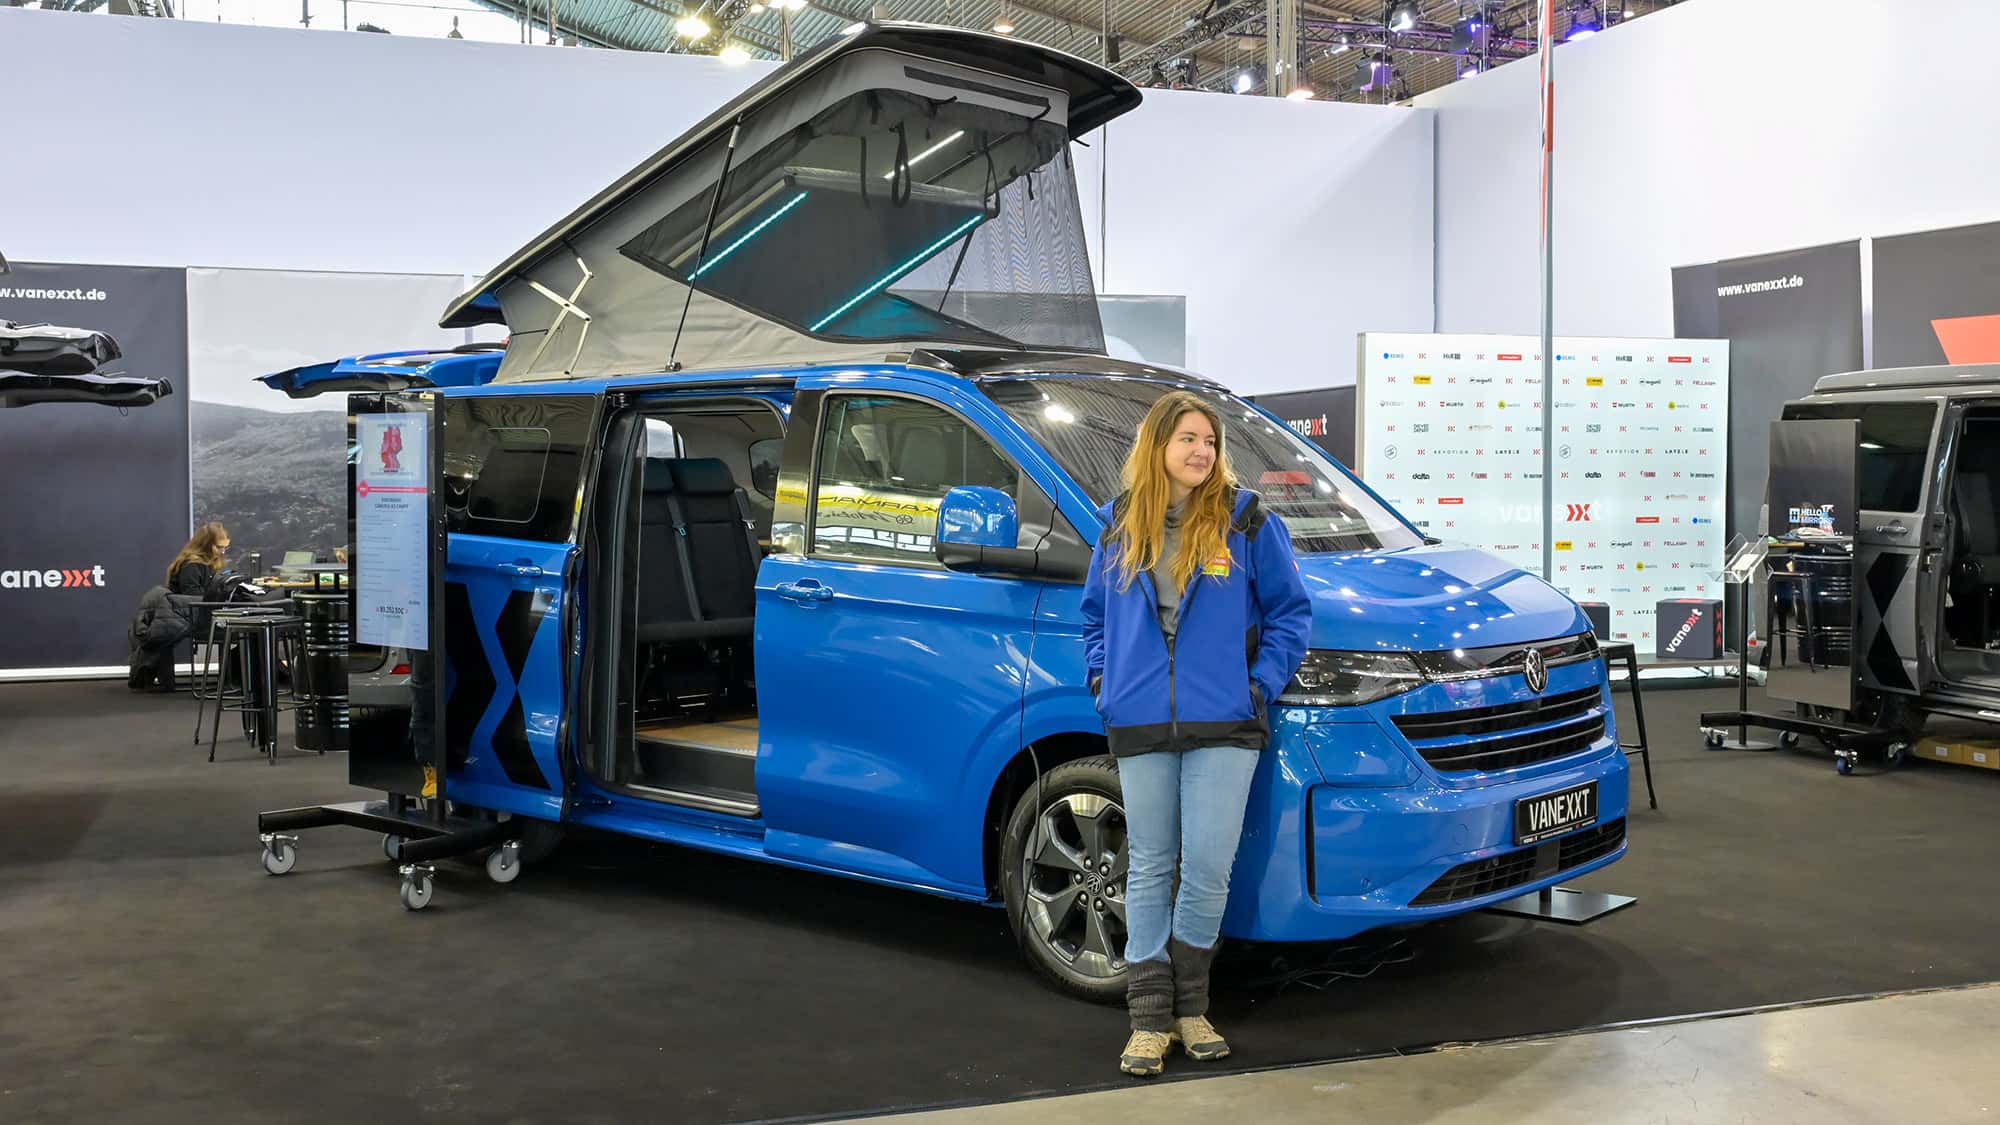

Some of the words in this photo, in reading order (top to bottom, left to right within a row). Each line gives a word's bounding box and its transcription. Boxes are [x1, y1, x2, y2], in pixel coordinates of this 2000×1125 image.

[1718, 275, 1803, 296] www.vanexxt.de
[1287, 414, 1327, 435] anexxt
[1801, 508, 1822, 516] HELLO
[1666, 608, 1703, 653] vanexxt
[1529, 788, 1590, 831] VANEXXT
